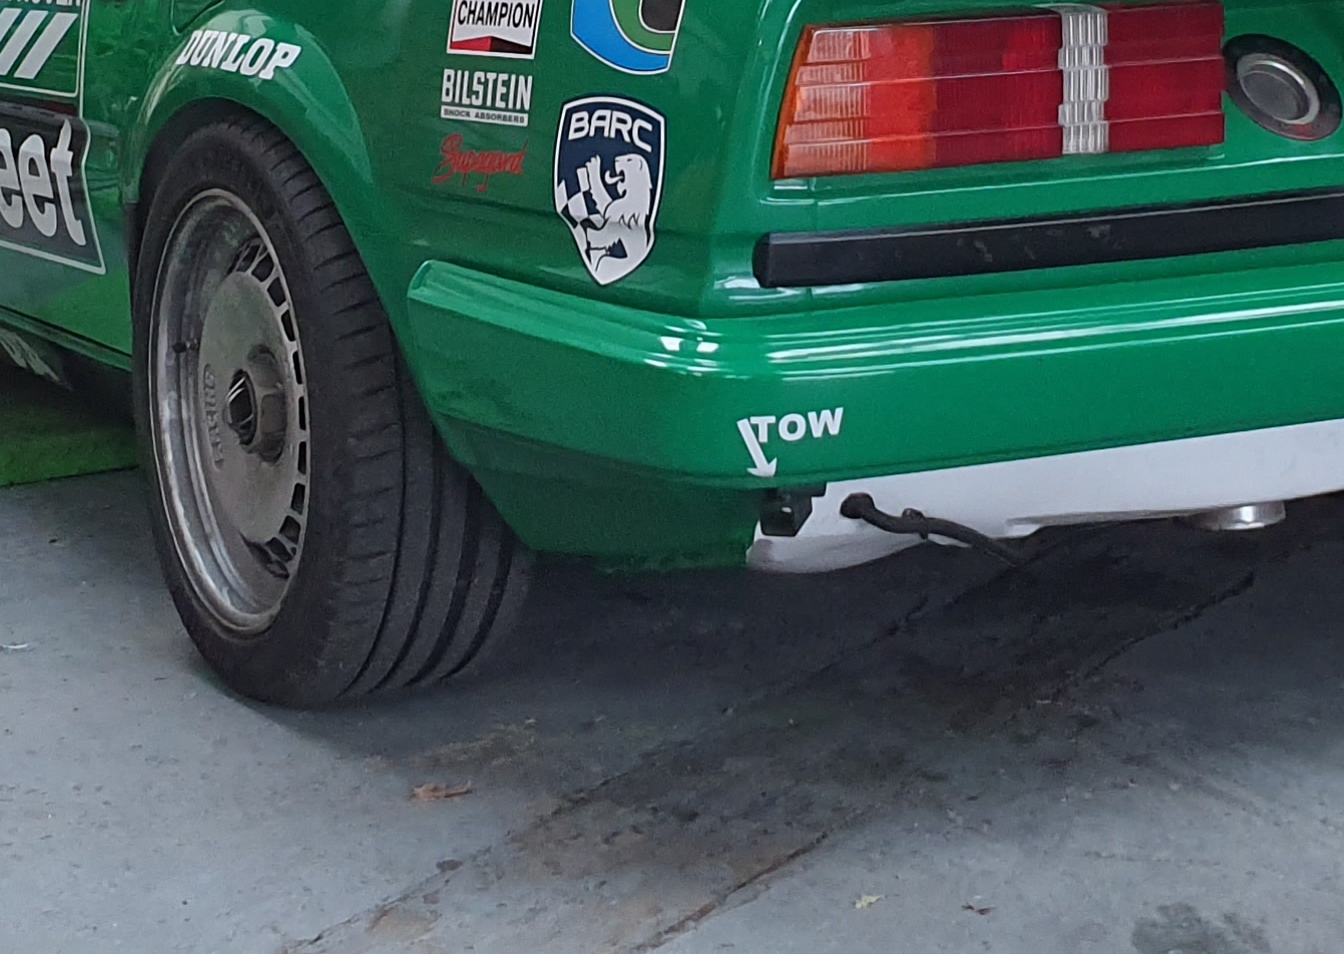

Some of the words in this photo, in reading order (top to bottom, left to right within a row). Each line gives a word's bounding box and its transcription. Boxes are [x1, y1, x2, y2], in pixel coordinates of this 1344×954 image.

[457, 0, 536, 29] CHAMPION
[175, 29, 302, 80] DUNLOP
[441, 68, 534, 112] BILSTEIN
[442, 107, 472, 119] SHOCK
[567, 109, 653, 153] BARC
[749, 406, 844, 444] TOW
